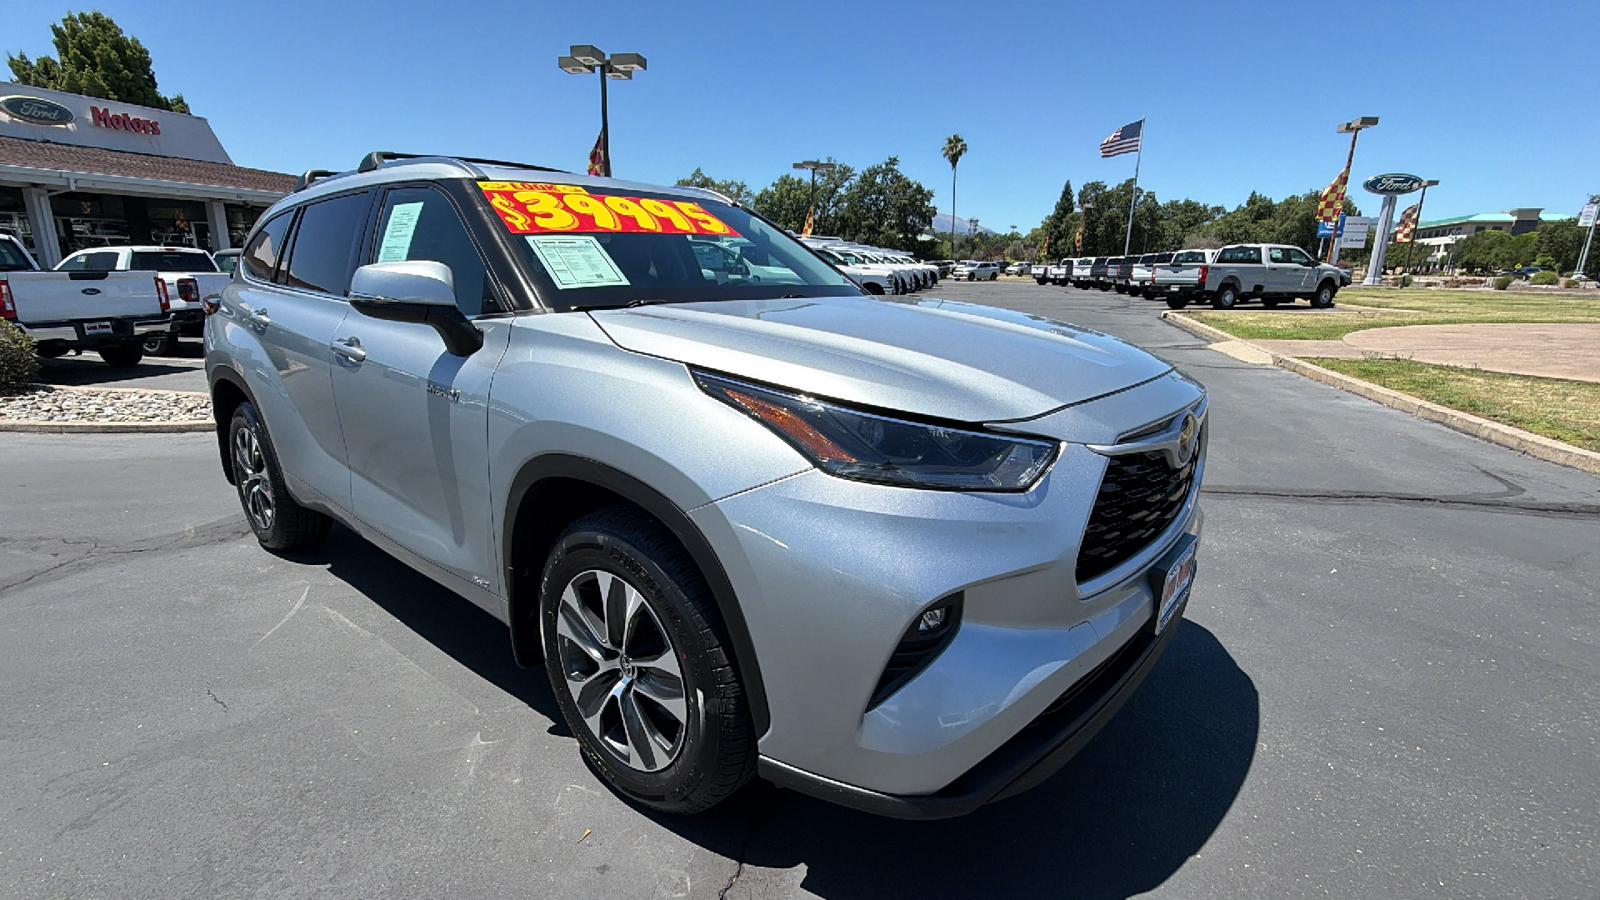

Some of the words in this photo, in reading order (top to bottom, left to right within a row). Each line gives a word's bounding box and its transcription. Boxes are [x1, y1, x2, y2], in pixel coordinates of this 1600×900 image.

[19, 101, 59, 120] Ford
[90, 106, 161, 136] Motors
[1376, 177, 1414, 190] Ford
[491, 191, 731, 234] $39995
